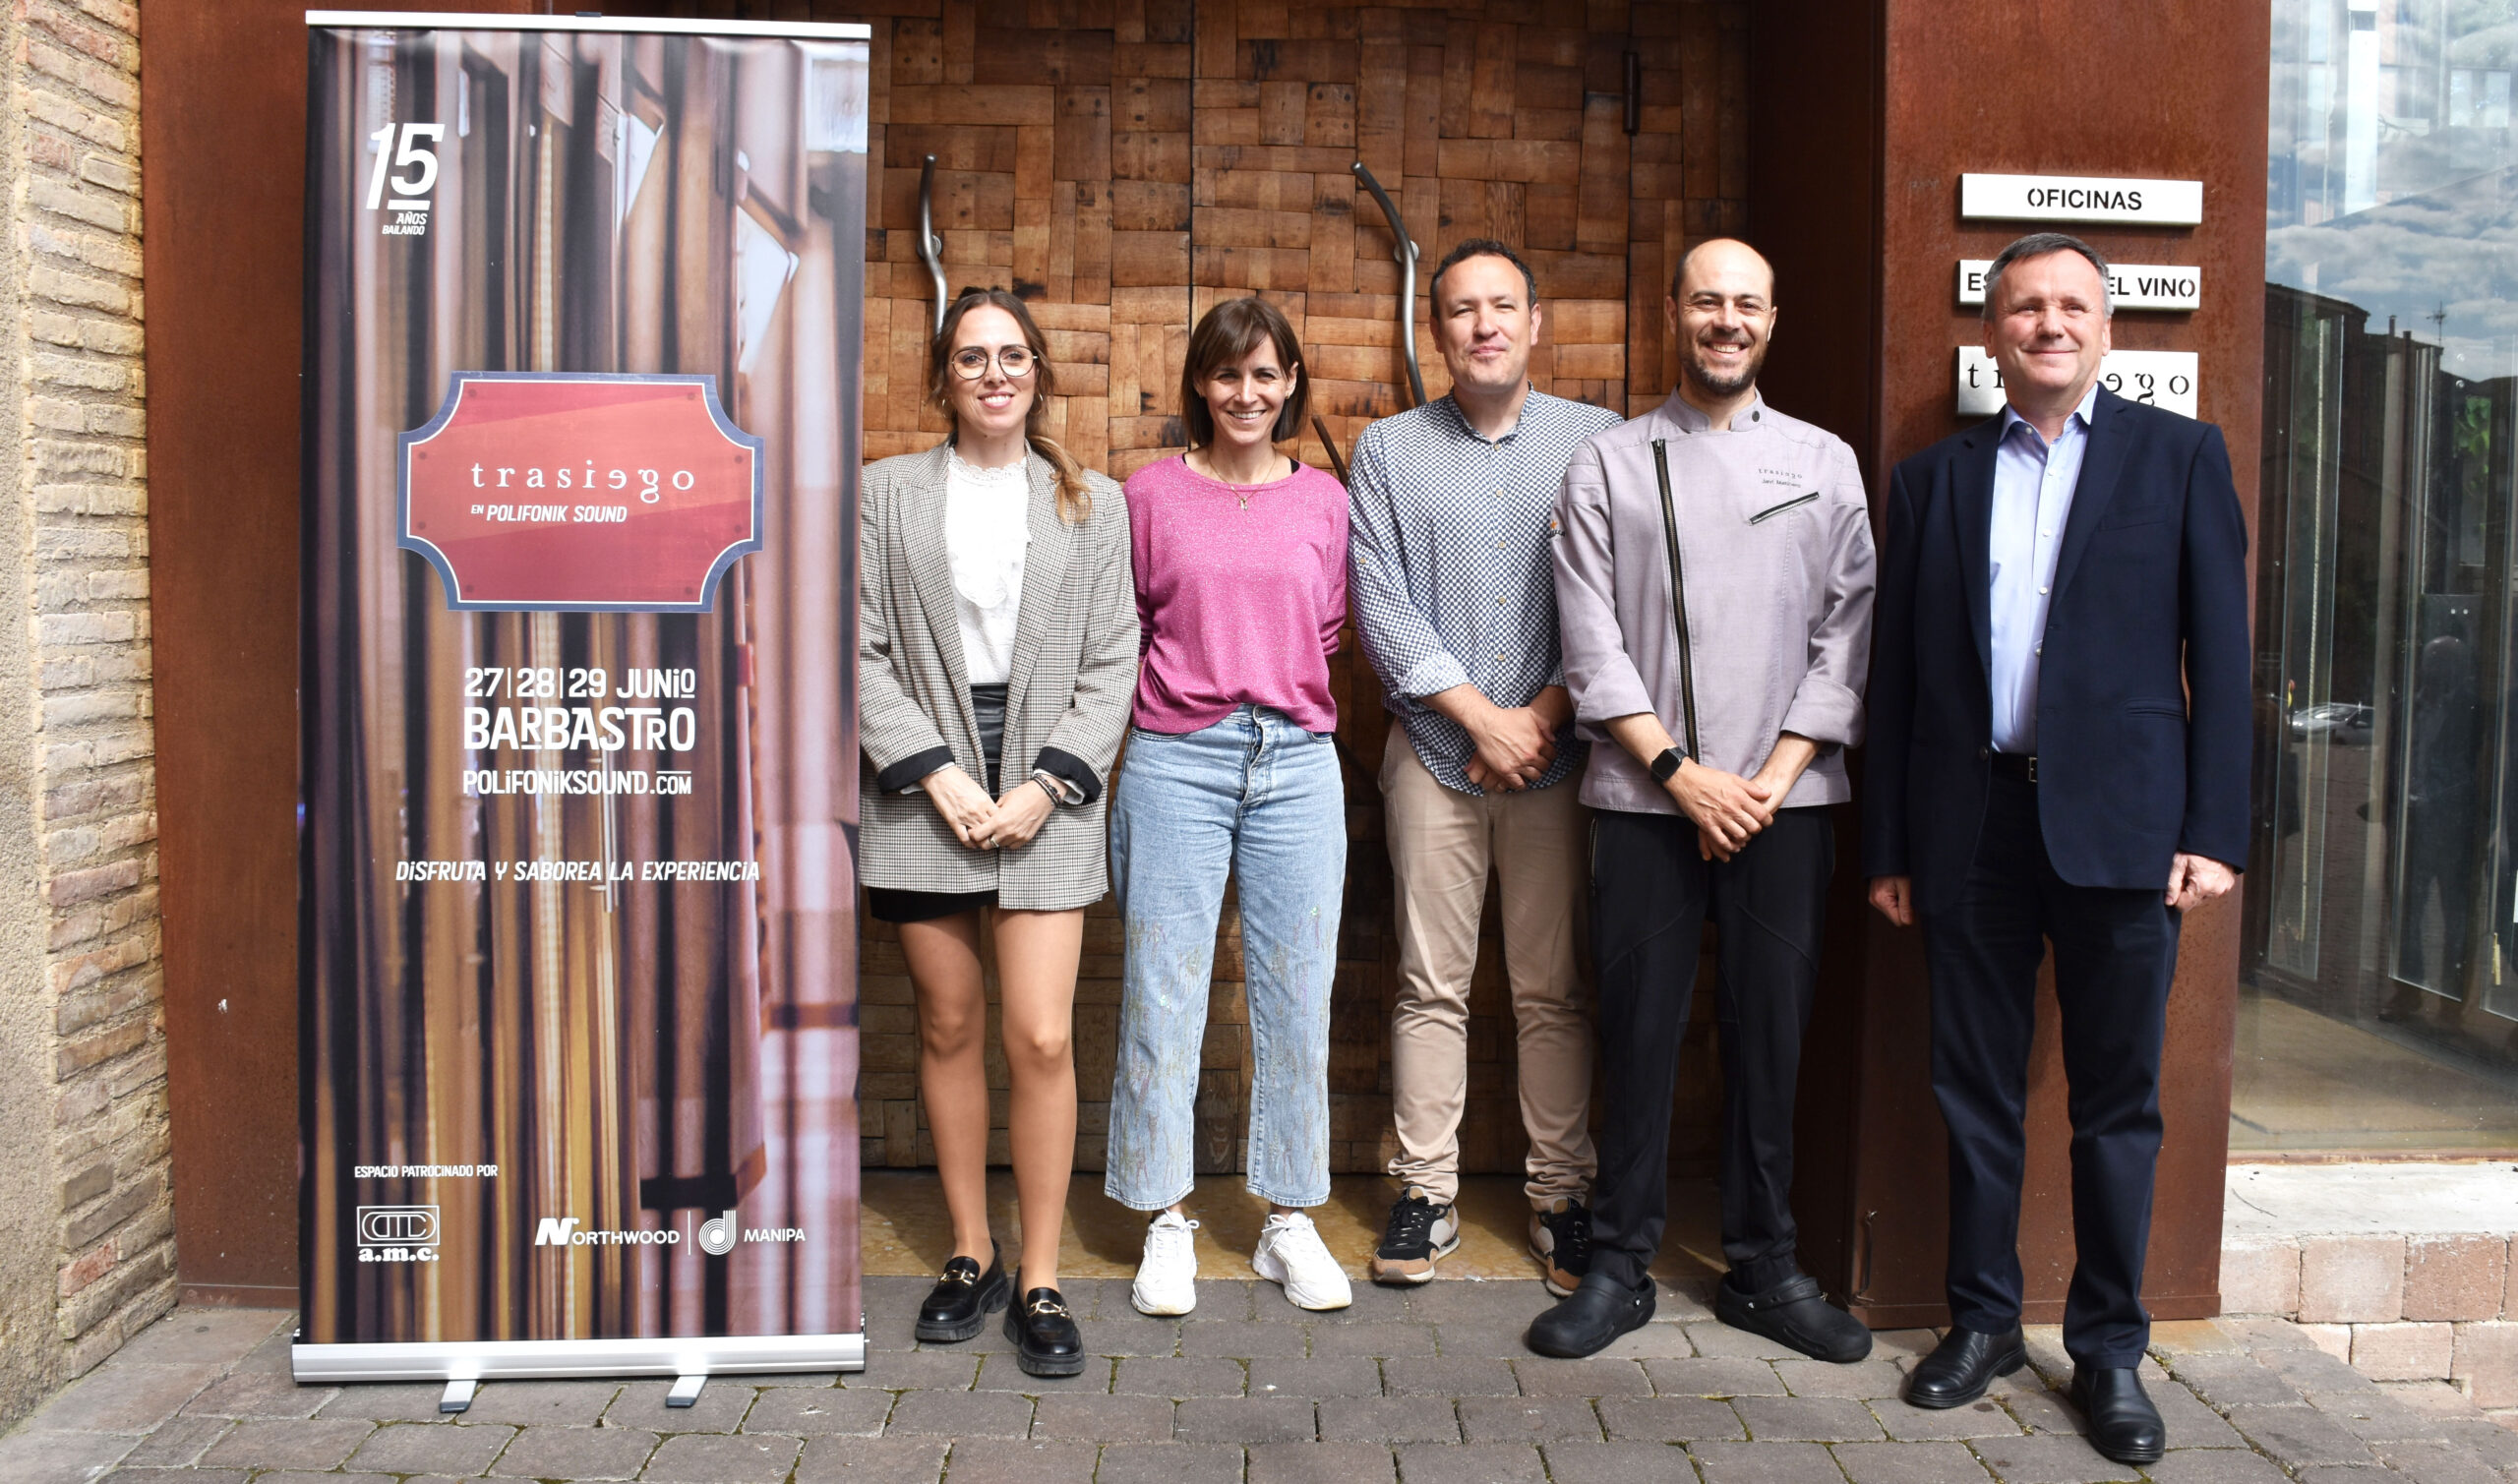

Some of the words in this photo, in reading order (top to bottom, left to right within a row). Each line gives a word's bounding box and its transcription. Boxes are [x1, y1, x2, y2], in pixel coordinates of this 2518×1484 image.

[366, 123, 446, 209] 15
[2027, 188, 2142, 210] OFICINAS
[395, 211, 428, 225] AÑOS
[2137, 277, 2195, 298] VINO
[471, 459, 694, 504] trasiego
[471, 505, 484, 514] EN
[486, 505, 569, 522] POLIFONIK
[573, 505, 628, 523] SOUND
[463, 706, 696, 751] BARBASTRO
[495, 861, 508, 881] Y
[513, 861, 602, 881] SABOREA
[609, 861, 633, 881] LA
[476, 1164, 498, 1177] POR
[534, 1217, 681, 1246] NORTHWOOD
[744, 1227, 806, 1242] MANIPA
[358, 1247, 440, 1262] a.m.c.
